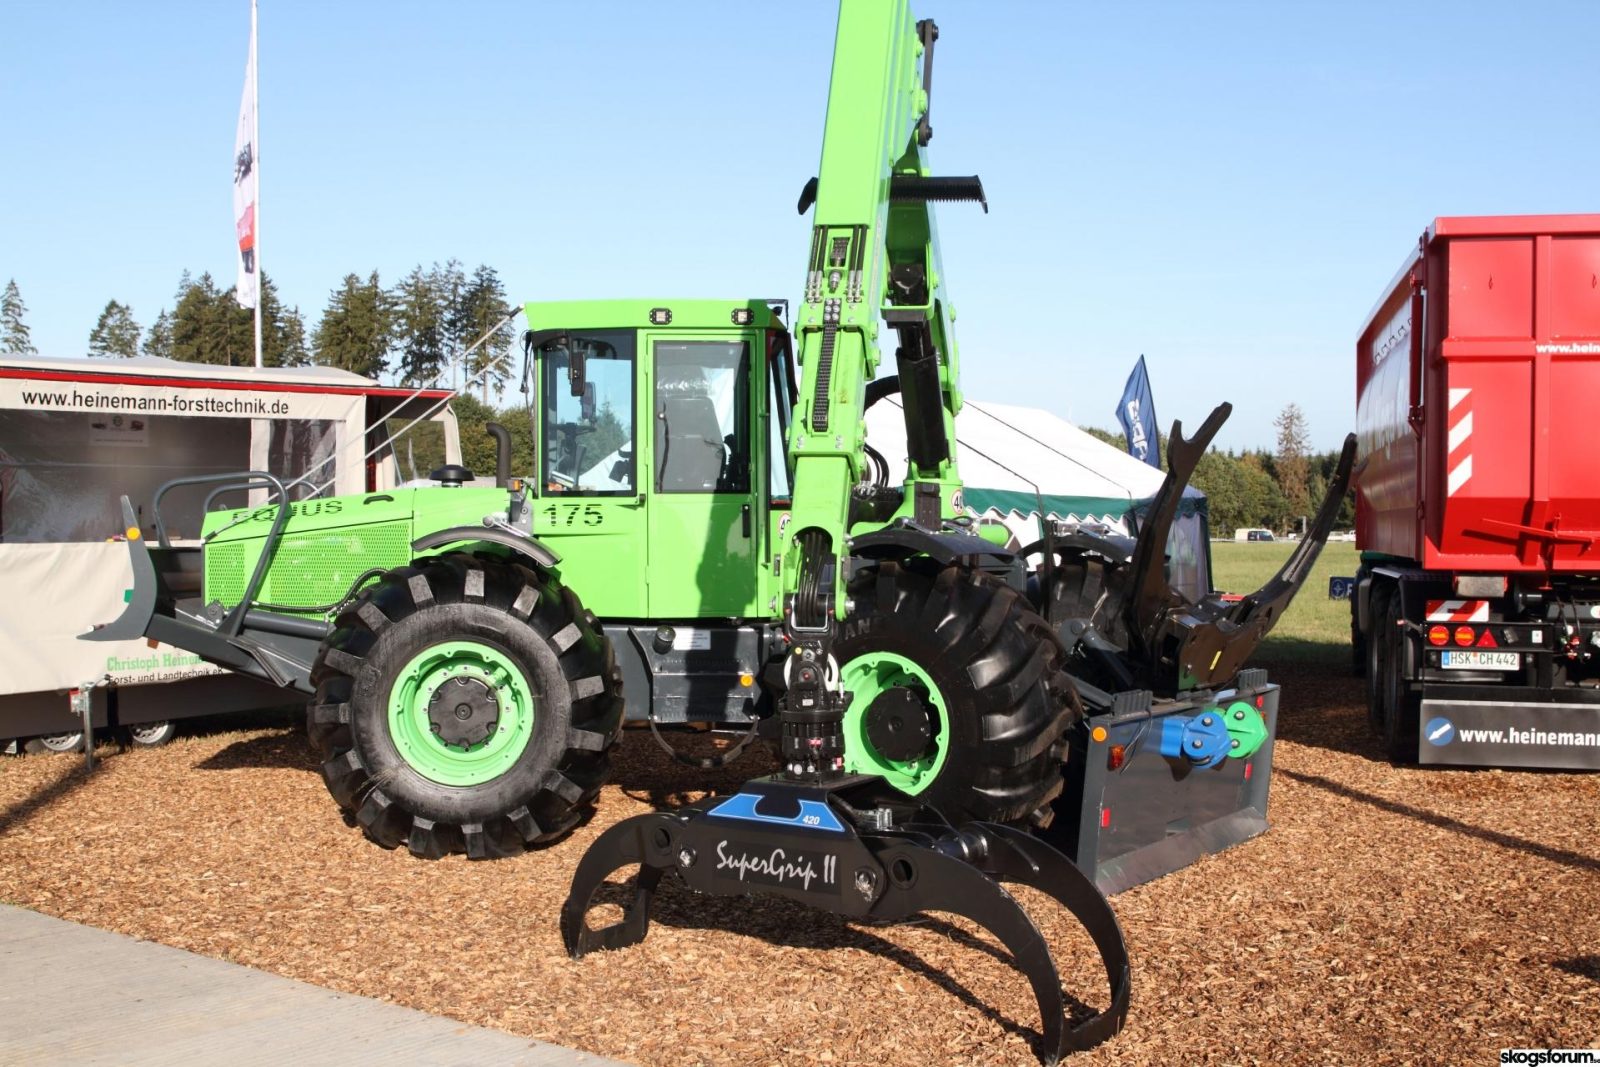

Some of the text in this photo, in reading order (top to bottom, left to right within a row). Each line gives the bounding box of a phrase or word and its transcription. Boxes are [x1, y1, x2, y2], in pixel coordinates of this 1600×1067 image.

[22, 390, 289, 414] www.heinemann-forsttechnik.de
[543, 504, 603, 527] 175
[106, 654, 160, 671] Christoph
[1450, 653, 1516, 666] HSK CH 442
[138, 673, 155, 683] und
[802, 815, 820, 825] 420
[716, 840, 817, 891] SuperGrip
